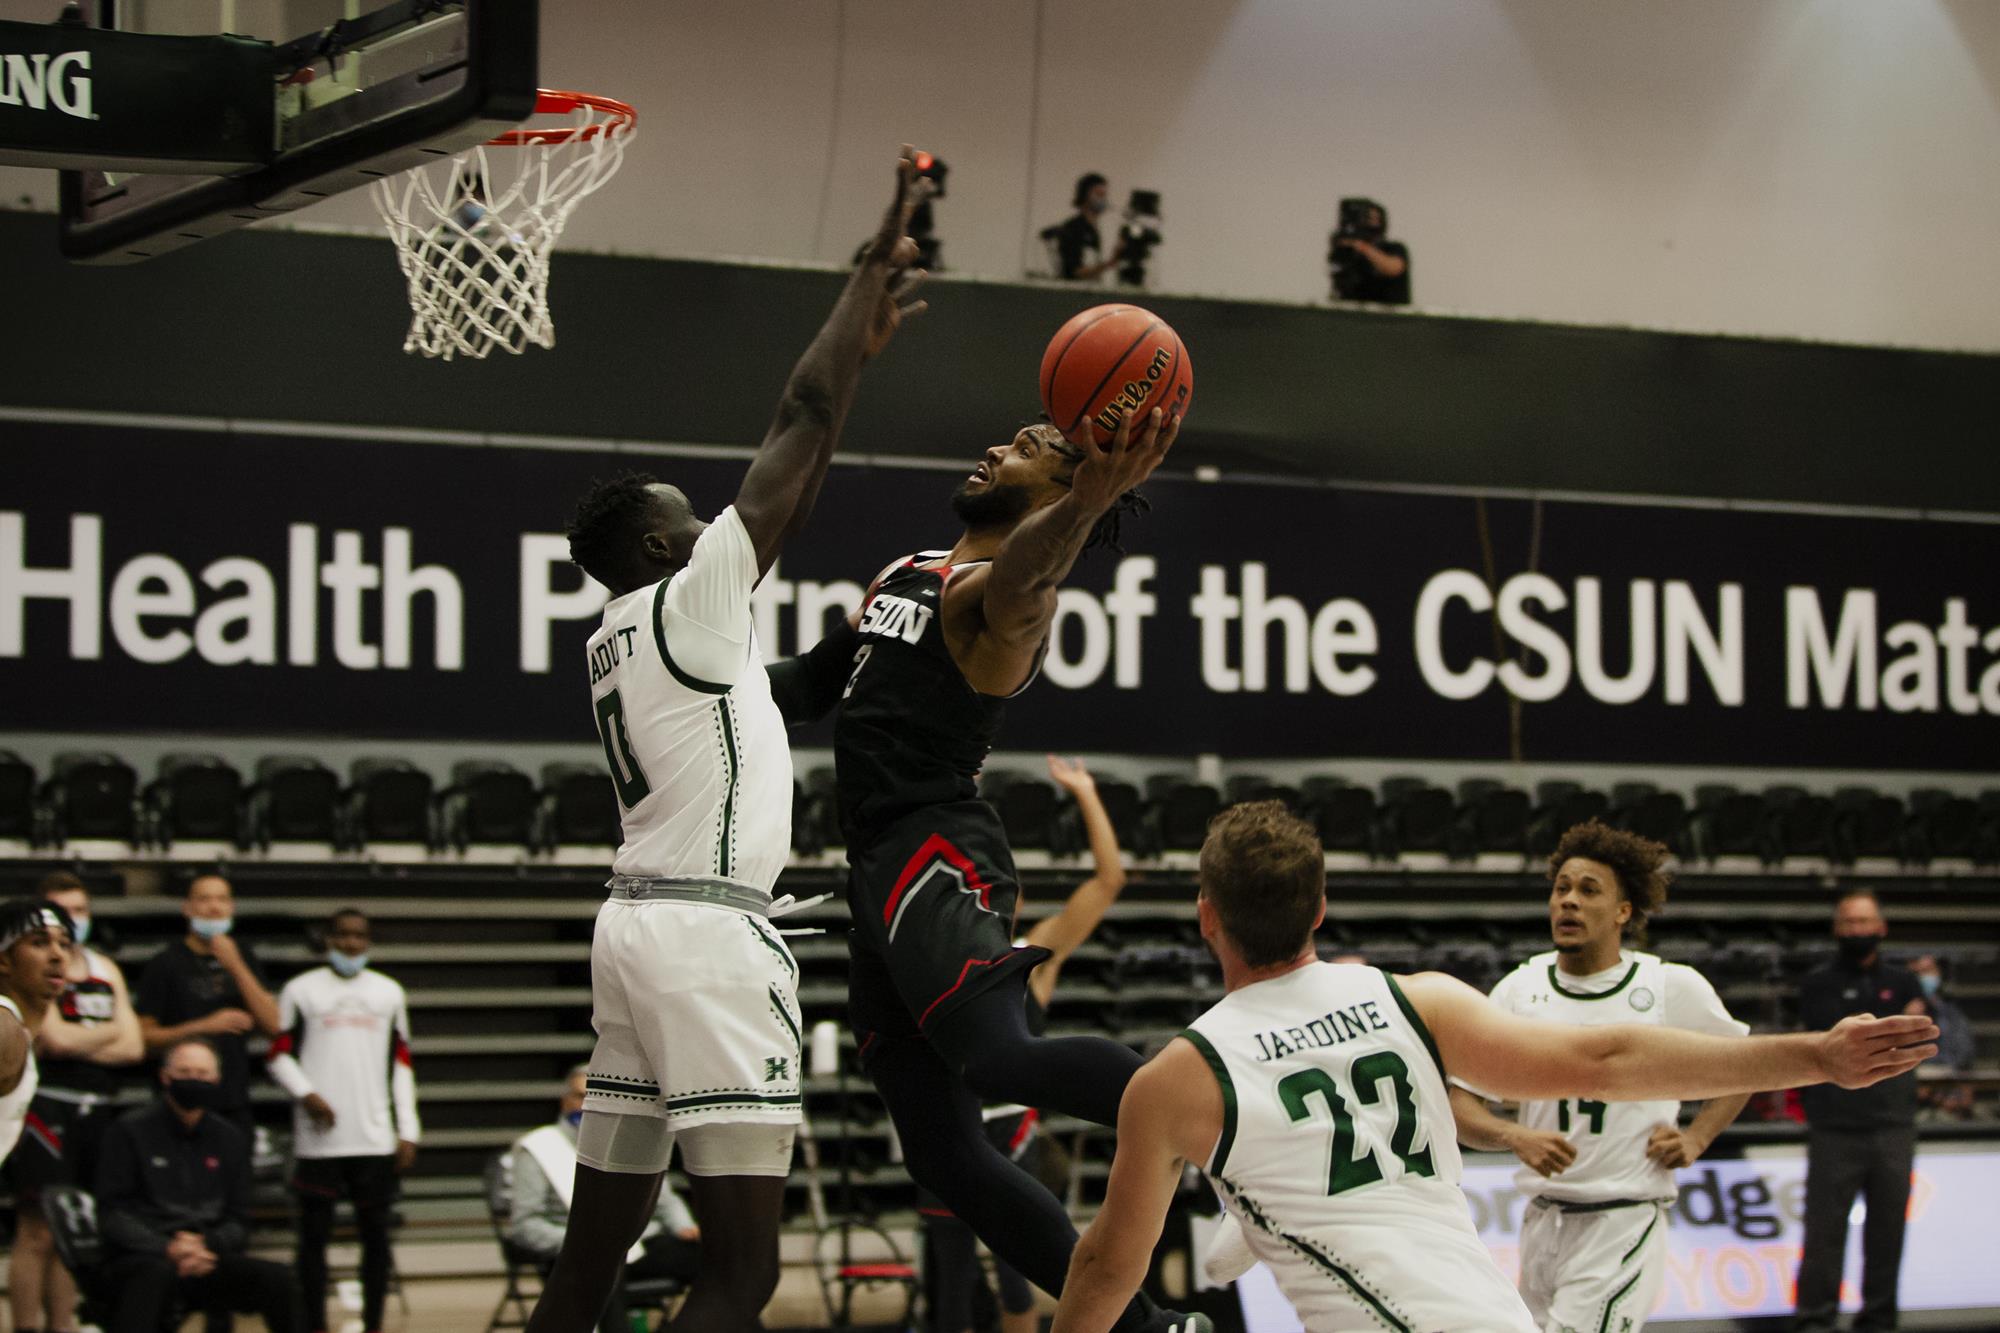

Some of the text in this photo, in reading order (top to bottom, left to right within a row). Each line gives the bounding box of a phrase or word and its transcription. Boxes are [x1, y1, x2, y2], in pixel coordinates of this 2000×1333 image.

[1096, 347, 1171, 432] Wilson
[0, 512, 463, 670] Health
[1042, 556, 1156, 689] of
[1191, 562, 1378, 696] the
[1415, 570, 1743, 706] CSUN
[858, 594, 933, 645] SUN
[591, 625, 637, 685] ADUT
[596, 686, 651, 810] 0
[1254, 1001, 1389, 1062] JARDINE
[1277, 1050, 1436, 1196] 22
